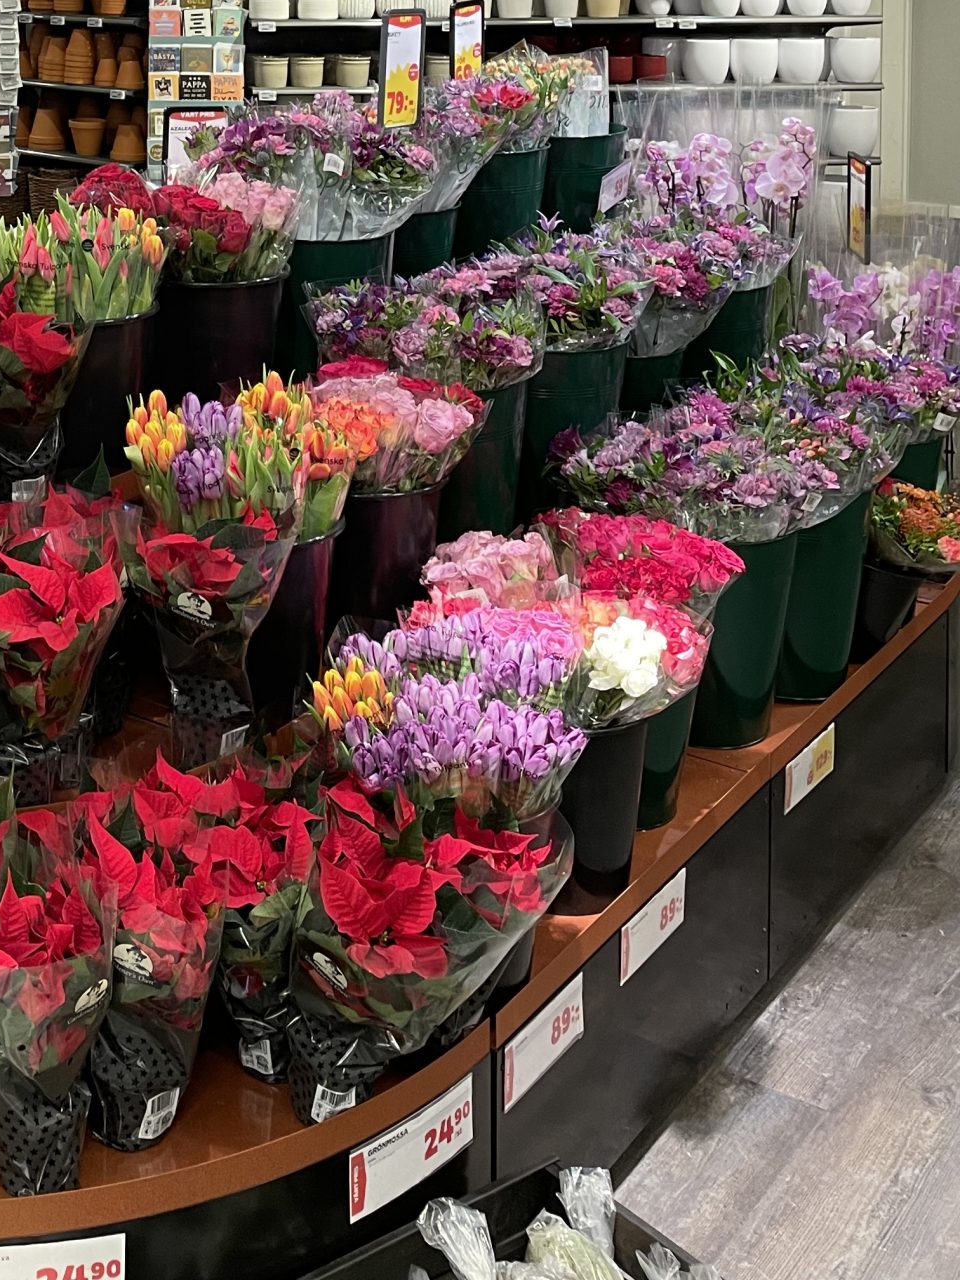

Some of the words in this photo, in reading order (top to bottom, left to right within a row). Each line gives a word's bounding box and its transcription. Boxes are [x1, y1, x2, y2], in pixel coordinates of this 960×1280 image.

[182, 80, 208, 89] PAPPA
[387, 91, 414, 115] 79:-
[367, 1128, 409, 1157] GRÖNMOSSA
